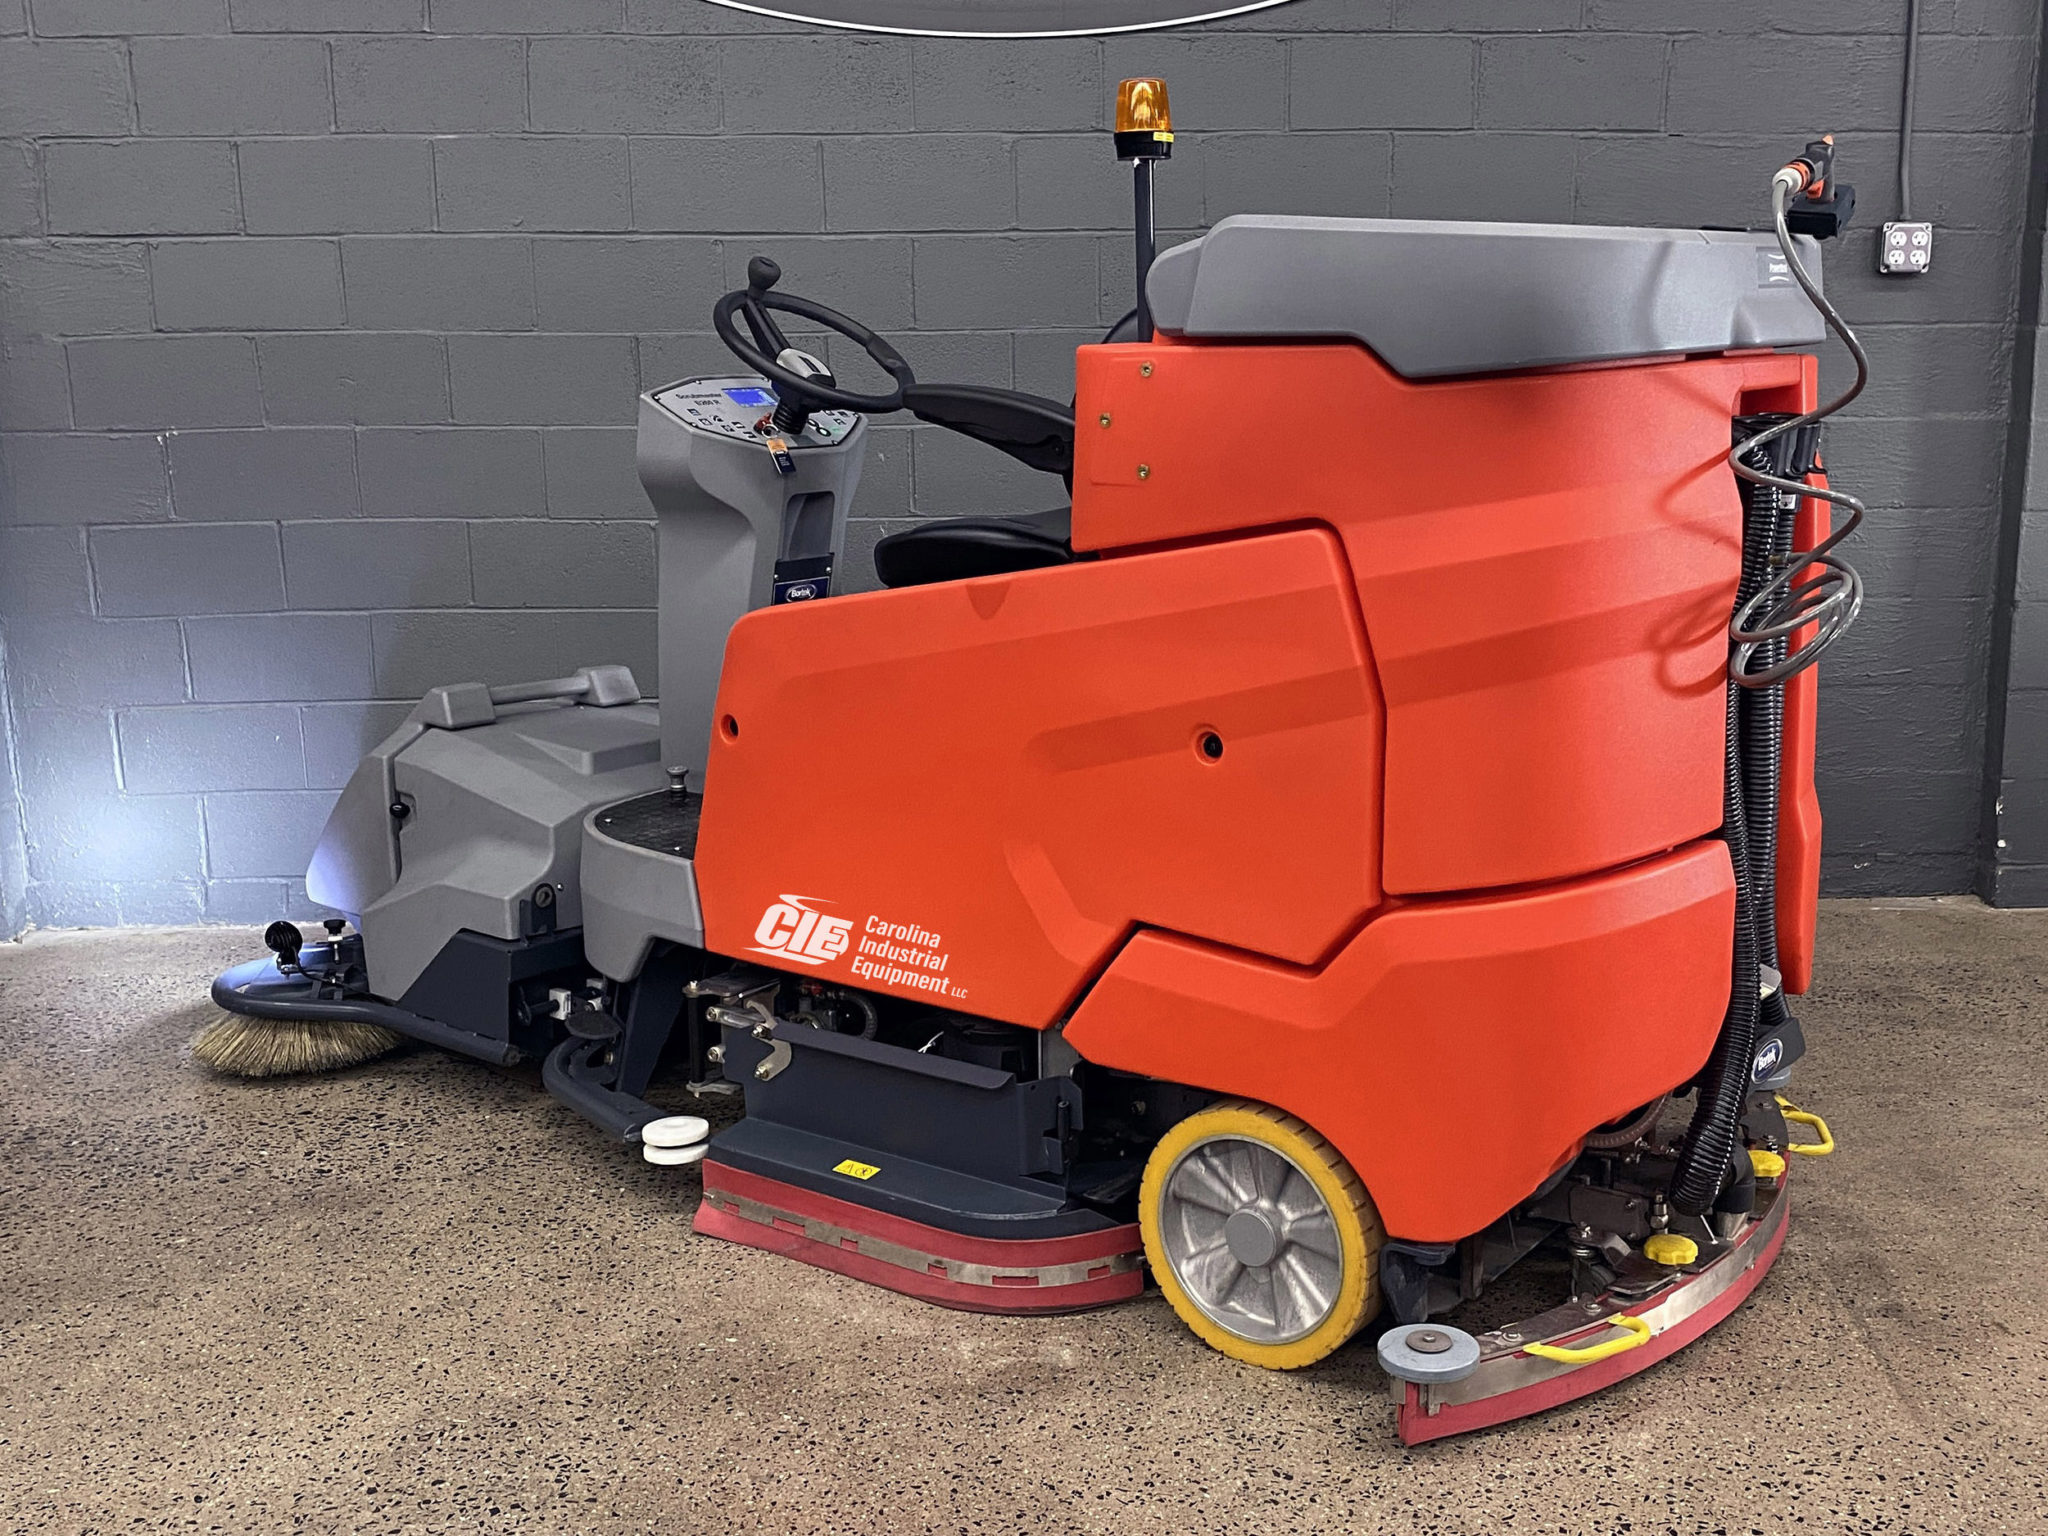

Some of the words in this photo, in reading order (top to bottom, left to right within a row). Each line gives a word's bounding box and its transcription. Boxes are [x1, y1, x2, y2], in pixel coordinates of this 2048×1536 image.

[754, 903, 854, 961] CIE
[865, 915, 942, 949] Carolina
[858, 935, 949, 972] Industrial
[850, 955, 950, 995] Equipment
[951, 986, 968, 999] LLC
